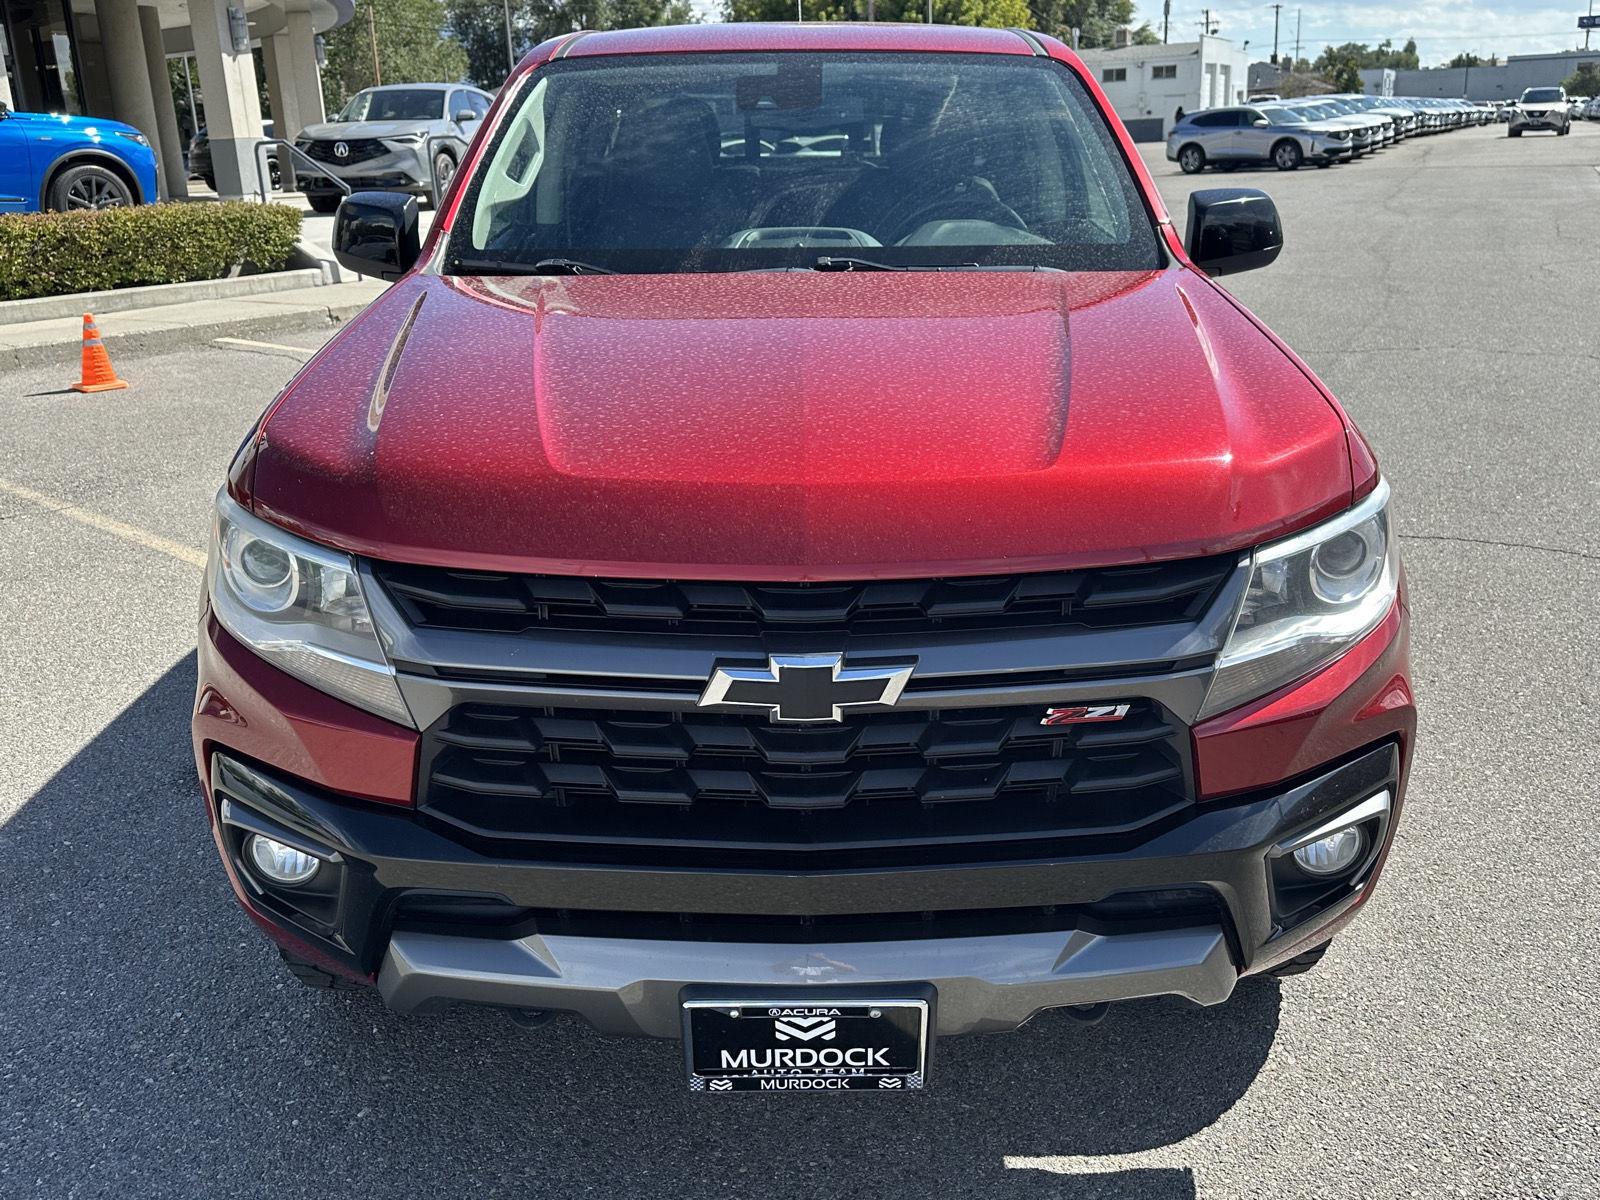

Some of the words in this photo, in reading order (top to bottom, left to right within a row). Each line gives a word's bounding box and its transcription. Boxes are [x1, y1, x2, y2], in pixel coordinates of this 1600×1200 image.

[781, 1008, 842, 1016] ACURA
[721, 1048, 890, 1068] MURDOCK
[760, 1078, 850, 1090] MURDOCK
